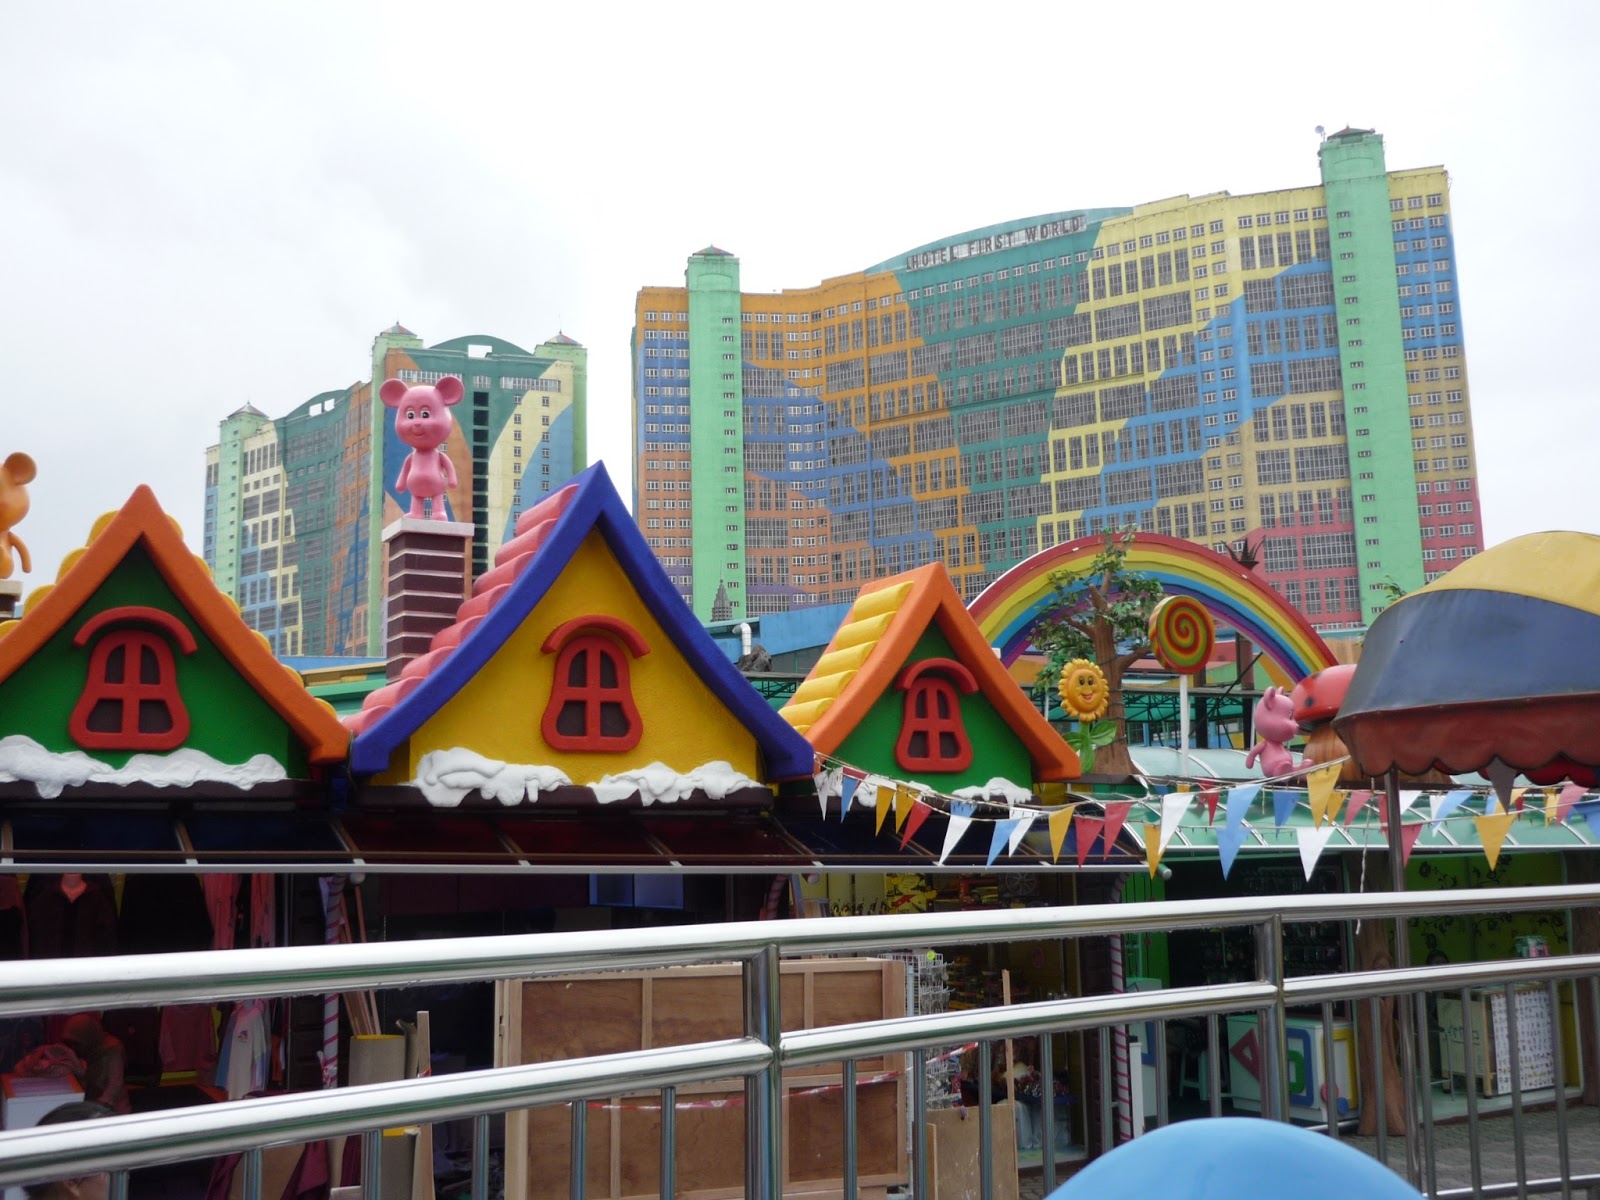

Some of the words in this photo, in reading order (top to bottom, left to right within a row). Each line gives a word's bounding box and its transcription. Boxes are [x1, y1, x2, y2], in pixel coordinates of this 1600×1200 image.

[911, 246, 957, 270] HOTEL
[968, 232, 1013, 257] FIRST
[1025, 216, 1080, 242] WORLD
